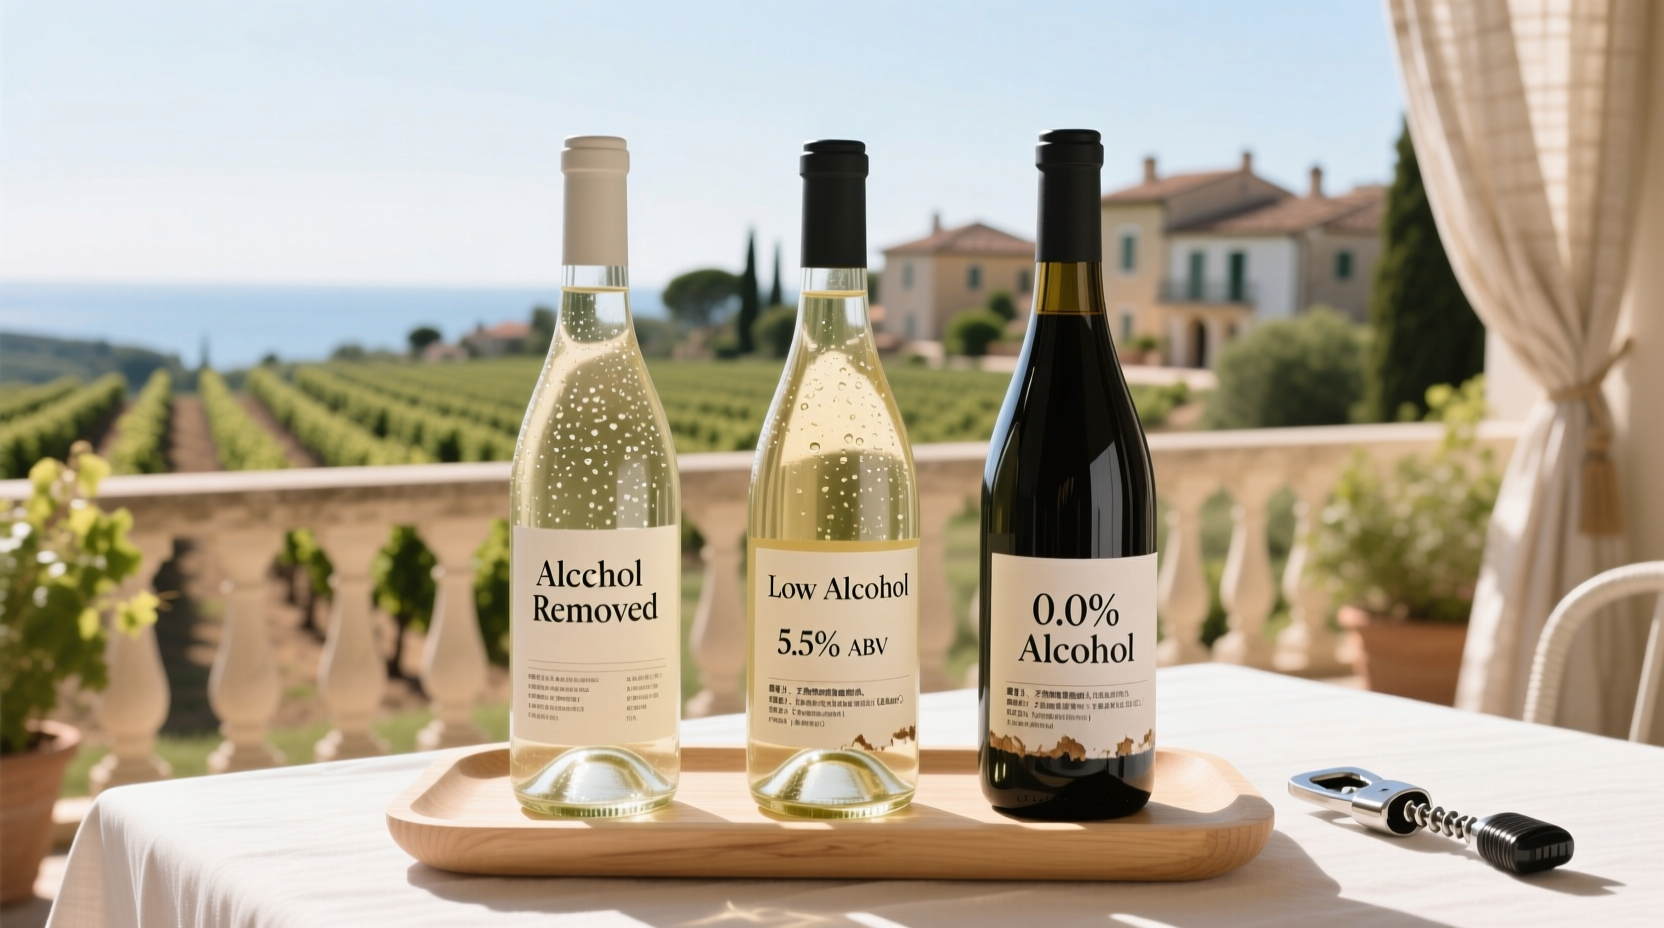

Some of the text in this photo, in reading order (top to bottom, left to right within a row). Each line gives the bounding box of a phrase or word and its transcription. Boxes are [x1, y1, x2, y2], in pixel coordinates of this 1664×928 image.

[536, 559, 643, 588] Alcchol
[768, 573, 909, 600] Low Alcohol
[533, 592, 658, 623] Removed
[1033, 593, 1119, 627] 0.0%
[778, 628, 888, 657] 5.5% ABV
[1018, 633, 1135, 664] Alcohol
